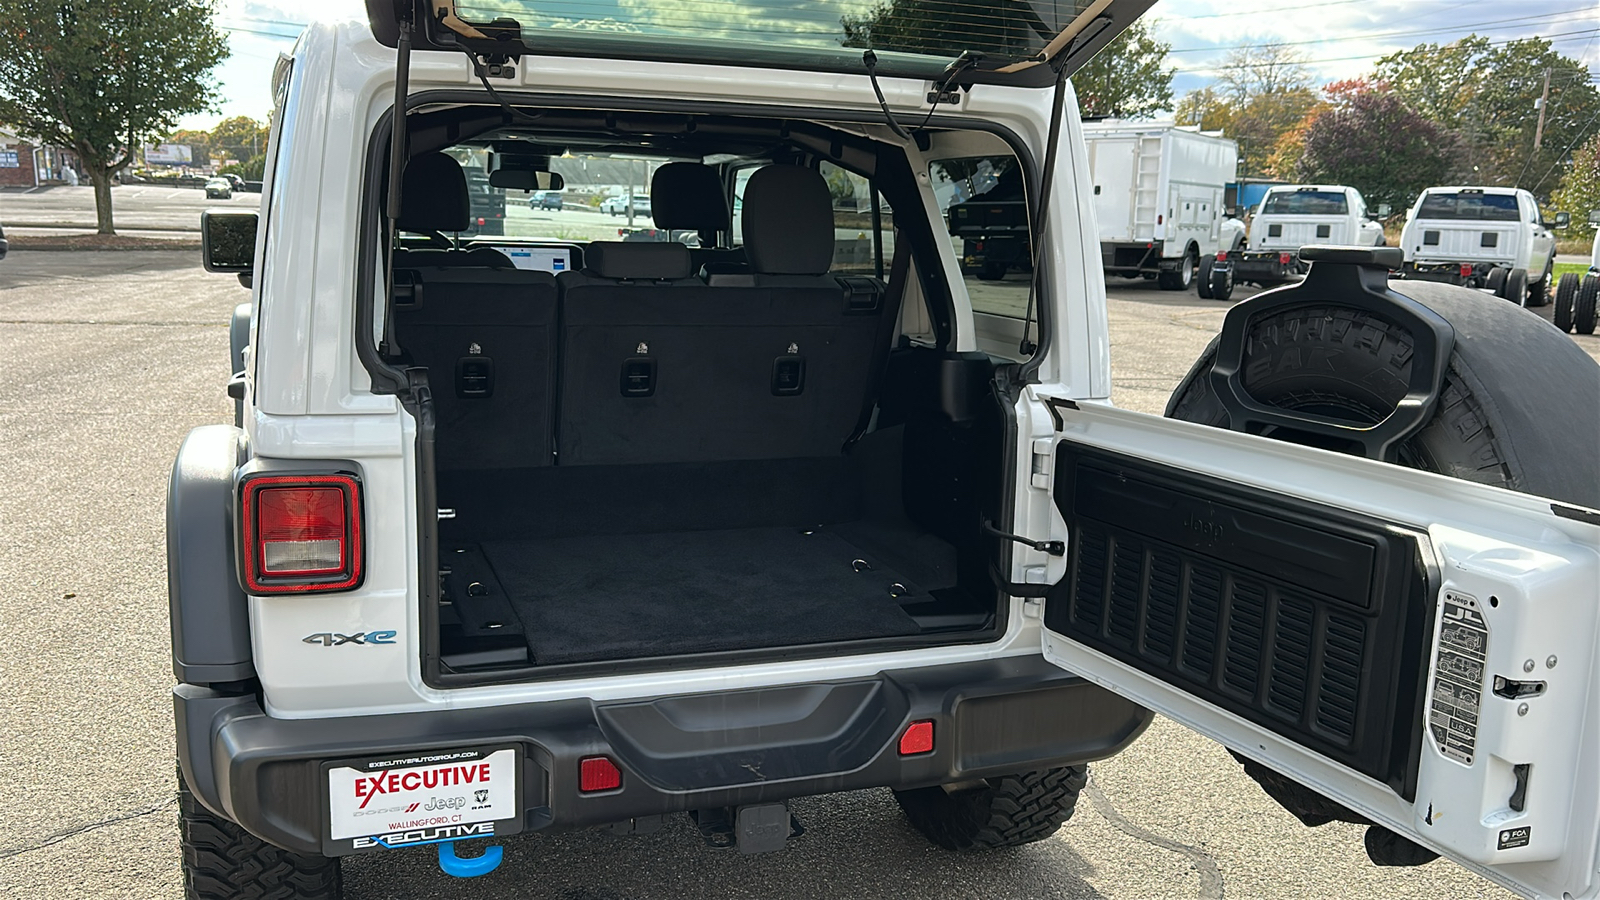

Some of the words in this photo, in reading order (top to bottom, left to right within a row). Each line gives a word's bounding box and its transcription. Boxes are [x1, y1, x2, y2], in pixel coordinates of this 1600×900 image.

[1183, 512, 1224, 541] Jeep
[1452, 595, 1469, 606] Jeep
[369, 752, 478, 768] EXECUTIVEAUTOGROUP.COM
[354, 763, 490, 809] EXECUTIVE
[424, 796, 466, 811] Jeep
[388, 816, 450, 830] WALLINGFORD,
[451, 814, 463, 823] CT
[353, 821, 495, 849] EXECUTIVE
[745, 822, 782, 839] Jeep
